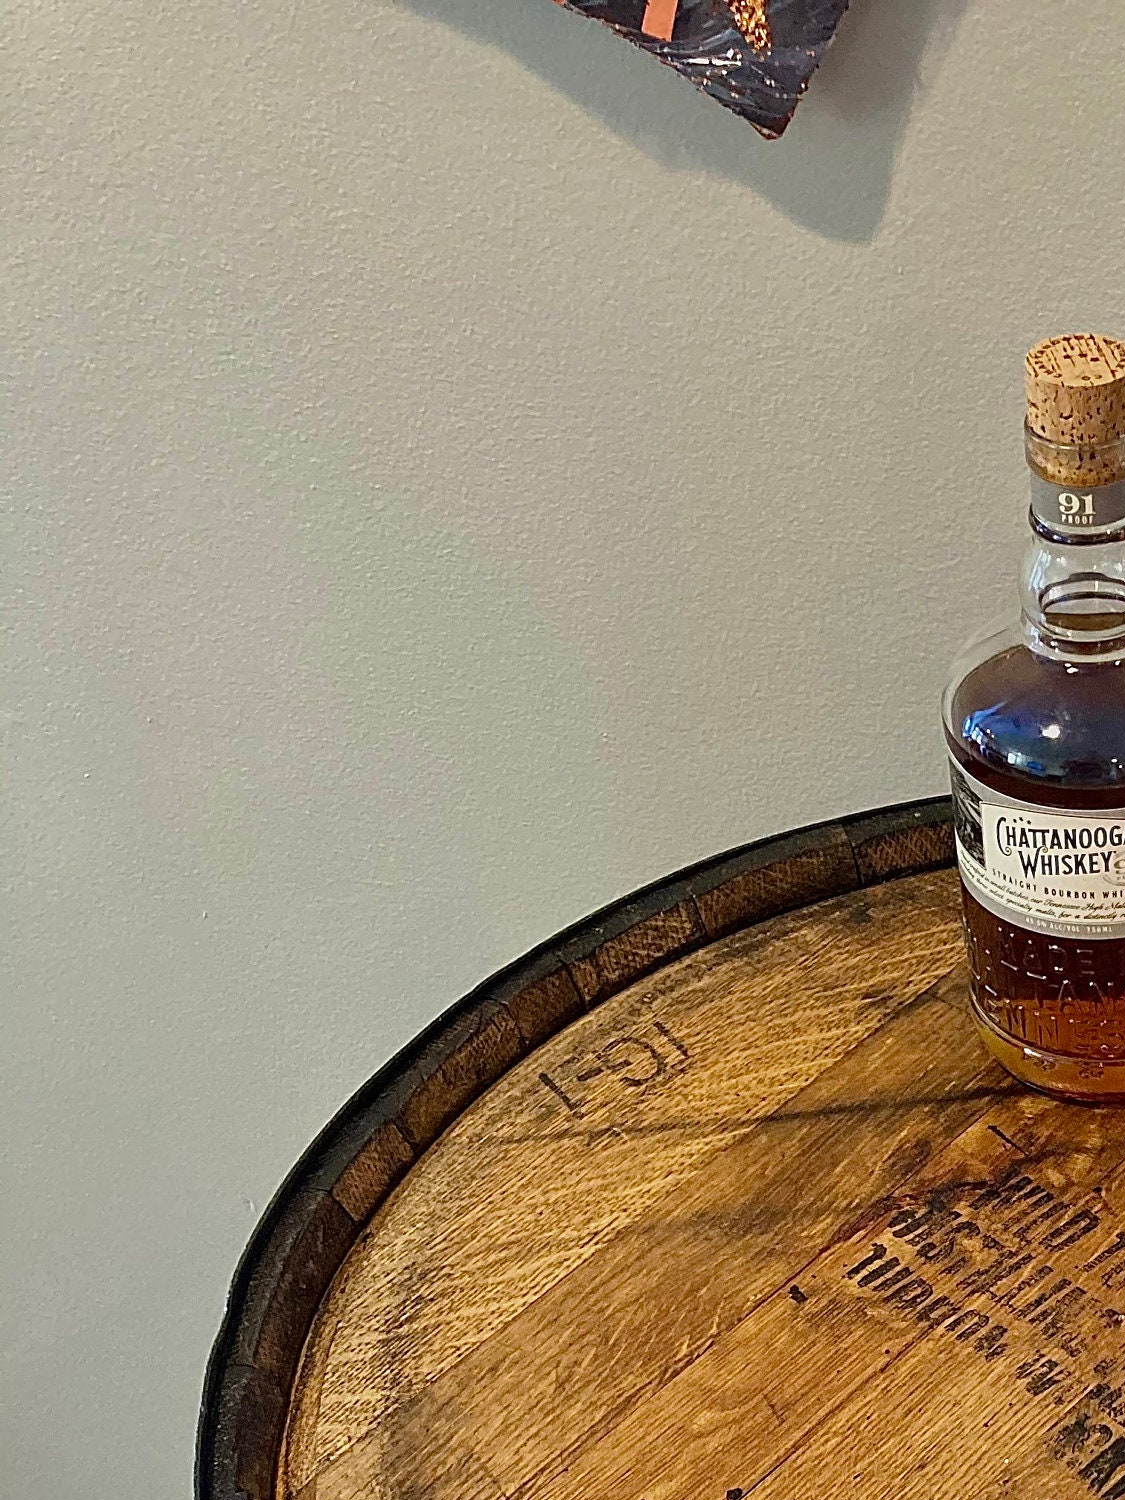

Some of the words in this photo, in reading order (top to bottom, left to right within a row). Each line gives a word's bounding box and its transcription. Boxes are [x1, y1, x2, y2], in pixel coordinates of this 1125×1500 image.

[1058, 493, 1096, 514] 91
[1061, 514, 1093, 524] PROOF
[1018, 844, 1114, 879] WHISKEY
[992, 868, 1037, 892] STRAIGHT
[1044, 887, 1095, 899] BOURBON
